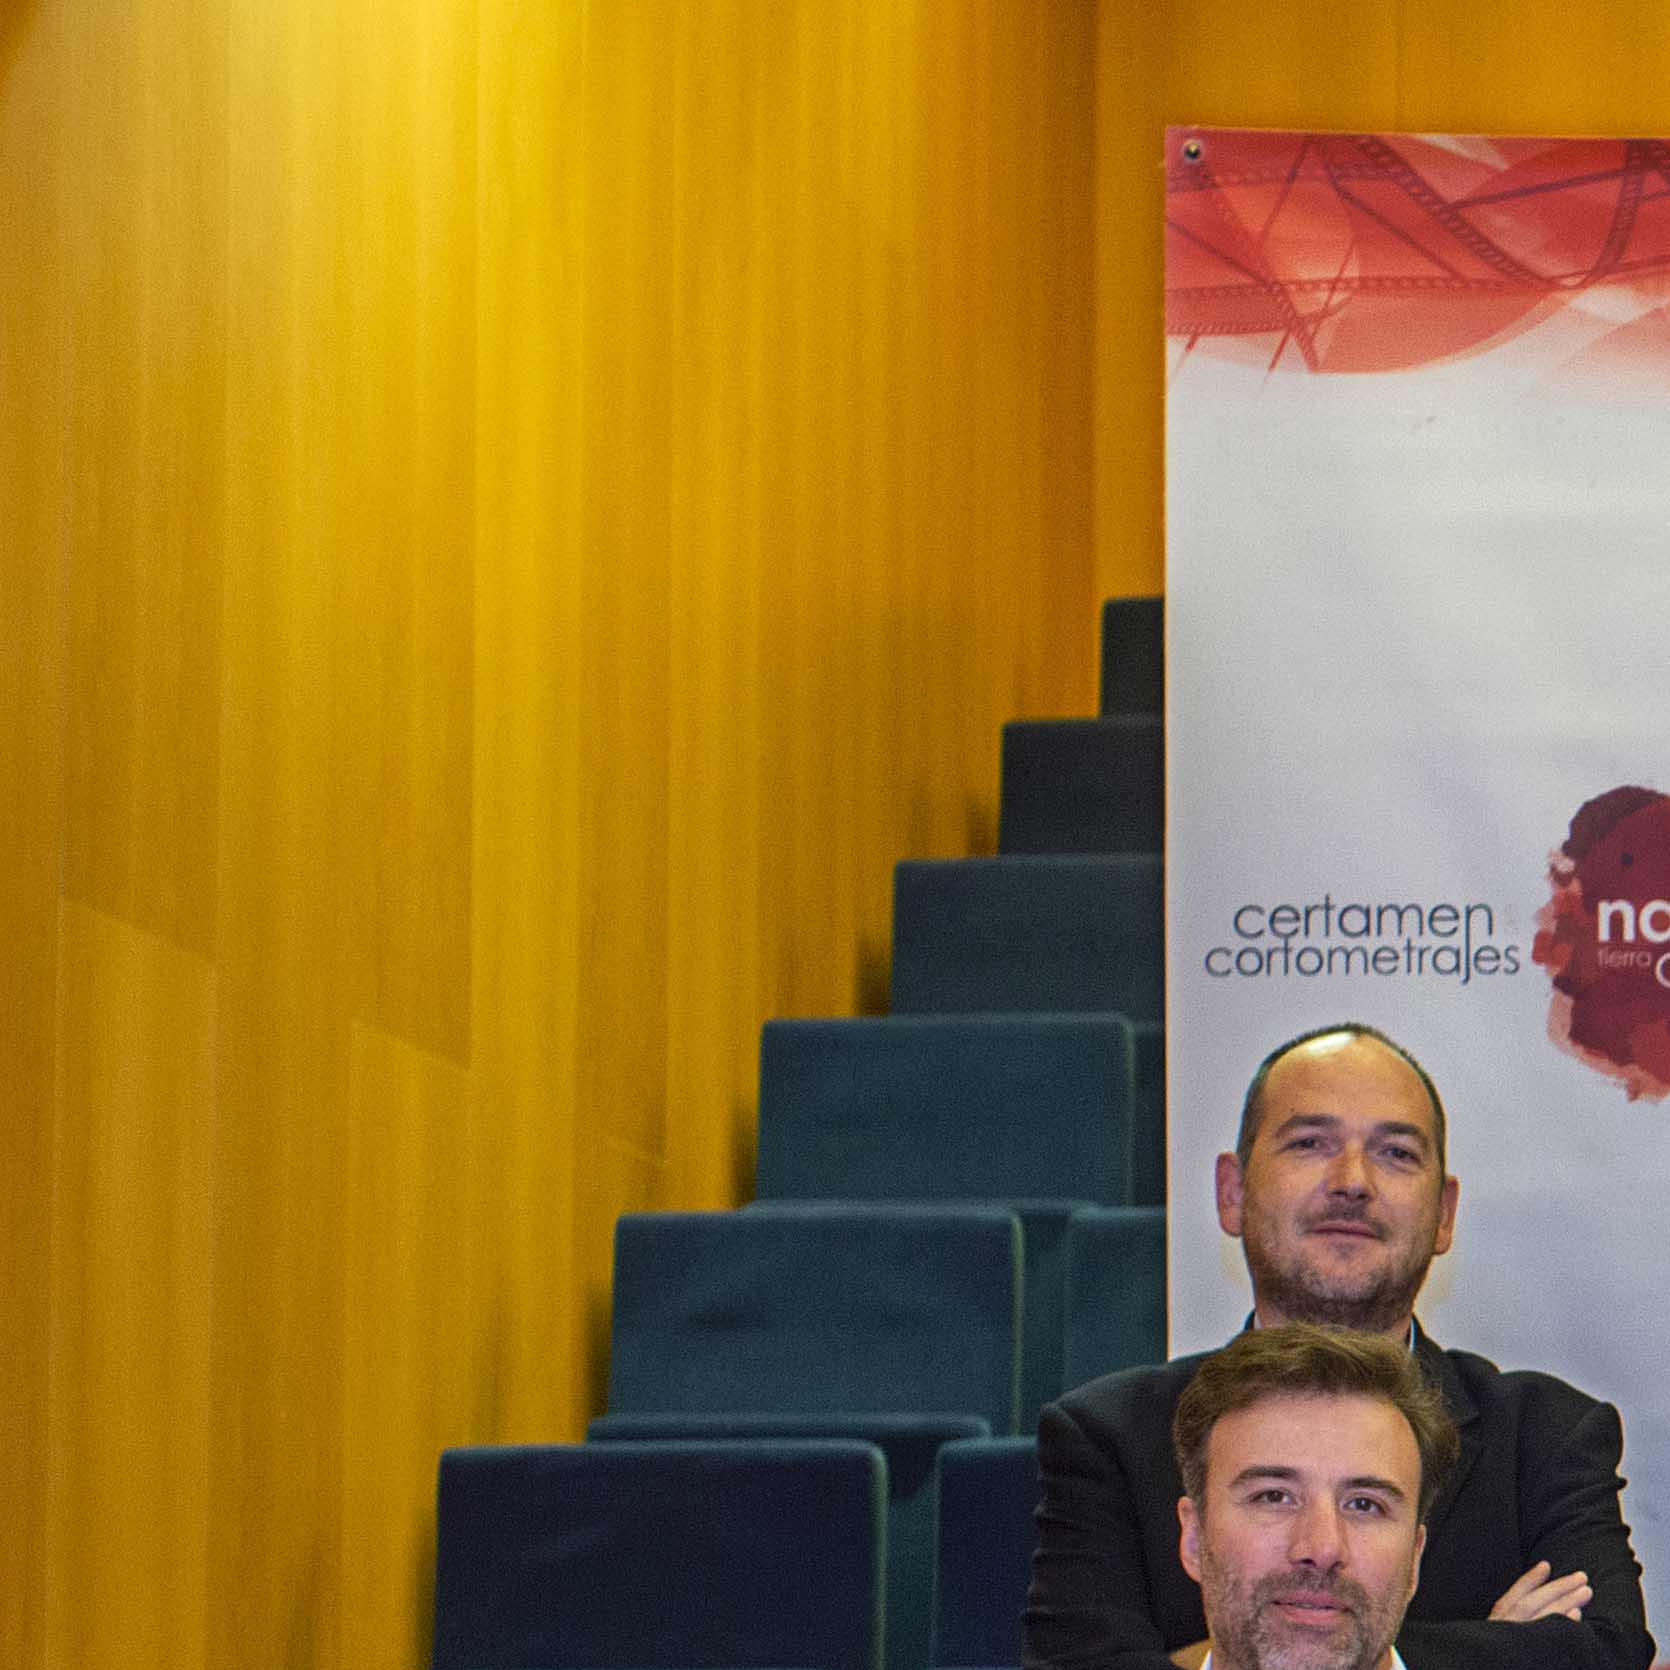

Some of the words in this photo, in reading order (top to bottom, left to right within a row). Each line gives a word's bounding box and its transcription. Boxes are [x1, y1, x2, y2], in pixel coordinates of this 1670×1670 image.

[1233, 893, 1494, 940] certamen
[1203, 936, 1521, 986] cortometrajes
[1598, 948, 1651, 969] tierra
